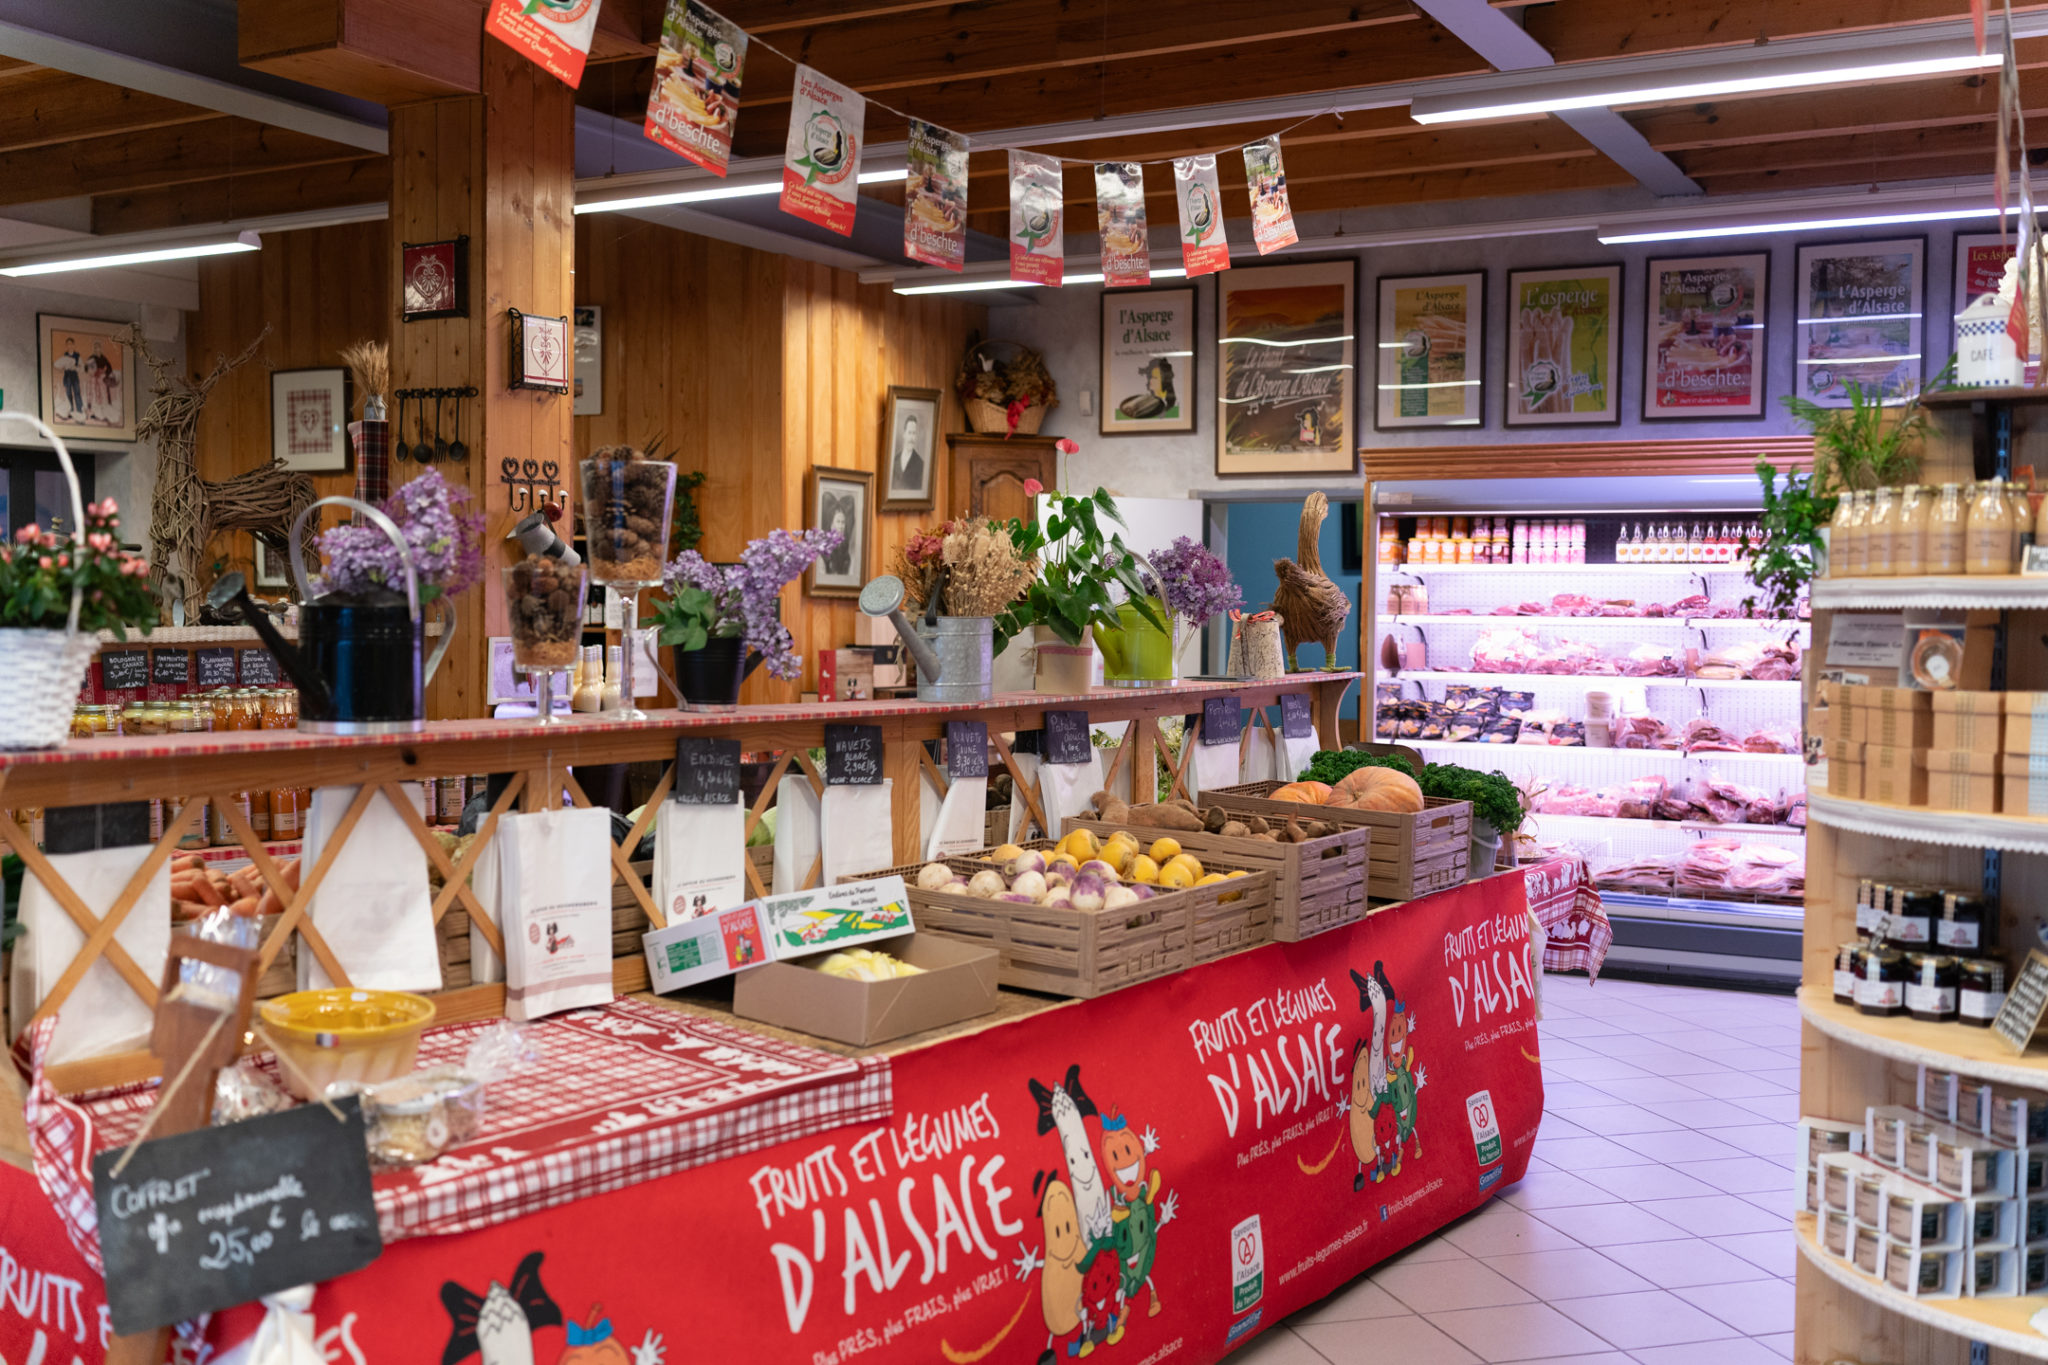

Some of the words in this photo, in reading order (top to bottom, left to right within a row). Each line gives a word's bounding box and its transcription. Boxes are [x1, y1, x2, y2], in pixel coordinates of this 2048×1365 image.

[667, 11, 703, 39] d'Alsace
[669, 0, 683, 14] Les
[685, 9, 722, 39] Asperges
[799, 87, 828, 106] d'Alsace
[800, 75, 812, 88] Les
[812, 81, 844, 103] Asperges
[655, 103, 722, 155] d'beschte.
[1972, 250, 1988, 262] Les
[1990, 248, 2017, 262] Asper
[1664, 273, 1680, 284] Les
[1684, 272, 1731, 286] Asperges
[1664, 283, 1707, 295] d'Alsace
[1526, 287, 1598, 310] L'asperge
[1839, 284, 1906, 300] L'Asperge
[1848, 299, 1906, 315] d'Alsace
[1119, 309, 1174, 327] l'Asperge
[1122, 328, 1171, 344] d'Alsace
[1242, 346, 1258, 369] Le
[1257, 346, 1286, 369] chant
[1236, 371, 1249, 398] de
[1664, 368, 1746, 388] d'beschte.
[835, 738, 872, 752] NAVETS
[690, 752, 735, 766] ENDIVE
[1444, 924, 1477, 968] FRUITS
[1477, 919, 1490, 950] ET
[1188, 1007, 1247, 1064] FRUITS
[1246, 997, 1269, 1037] ET
[1268, 977, 1337, 1029] LÉGUMES
[1207, 1022, 1346, 1138] D'ALSACE
[1237, 1151, 1249, 1169] Plus
[1271, 1135, 1282, 1154] plus
[1305, 1117, 1315, 1135] plus
[1475, 1126, 1496, 1141] l'Alsace
[749, 1145, 849, 1230] FRUITS
[849, 1127, 887, 1182] ET
[889, 1092, 1000, 1170] LÉGUMES
[1233, 1219, 1258, 1240] Savourez
[770, 1154, 1024, 1334] D'ALSACE
[1278, 1219, 1369, 1286] www.fruits-legumes-alsace.fr
[1236, 1261, 1261, 1282] l'Alsace
[1239, 1279, 1259, 1297] Produit
[883, 1319, 906, 1345] plus
[904, 1294, 953, 1328] FRAIS,
[953, 1285, 973, 1311] plus
[972, 1267, 1003, 1296] VRAI
[1235, 1299, 1243, 1310] du
